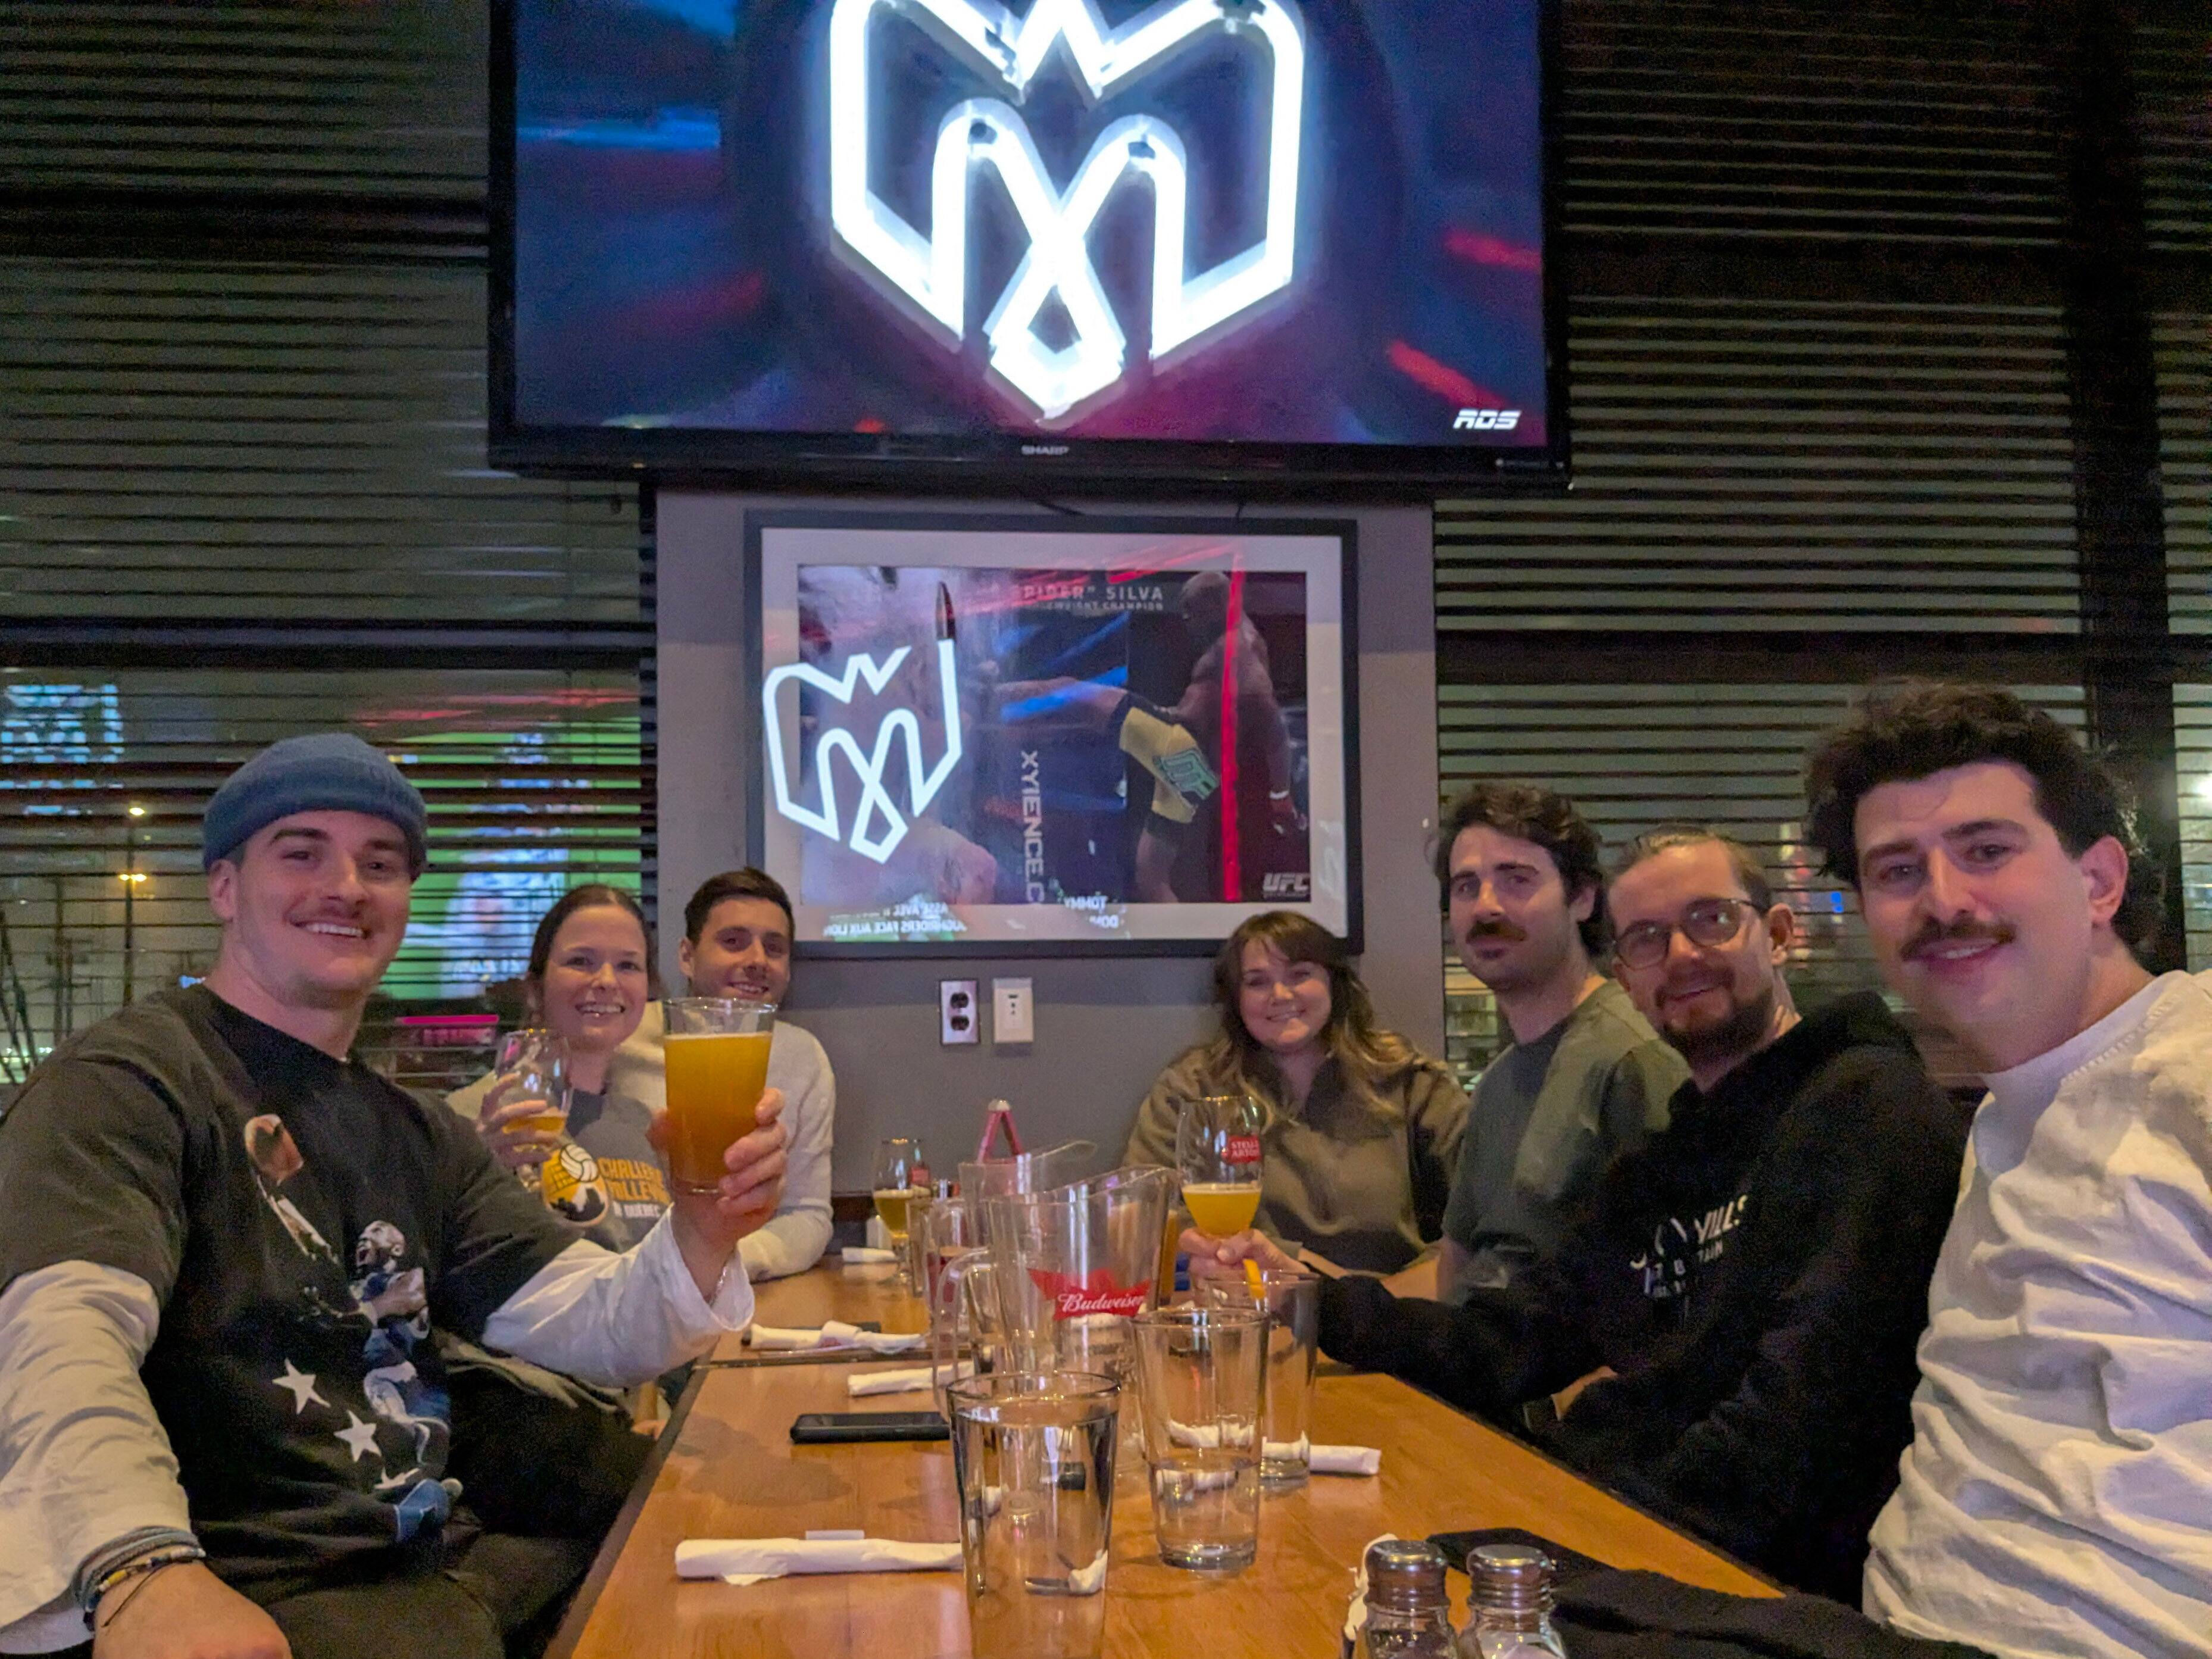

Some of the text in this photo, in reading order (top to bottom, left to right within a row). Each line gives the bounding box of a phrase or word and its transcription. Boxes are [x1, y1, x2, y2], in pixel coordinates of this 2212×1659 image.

[1020, 445, 1070, 455] SHARP
[1105, 586, 1163, 601] SILVA
[1262, 873, 1310, 892] UFC
[1058, 1294, 1145, 1312] Budweiser
